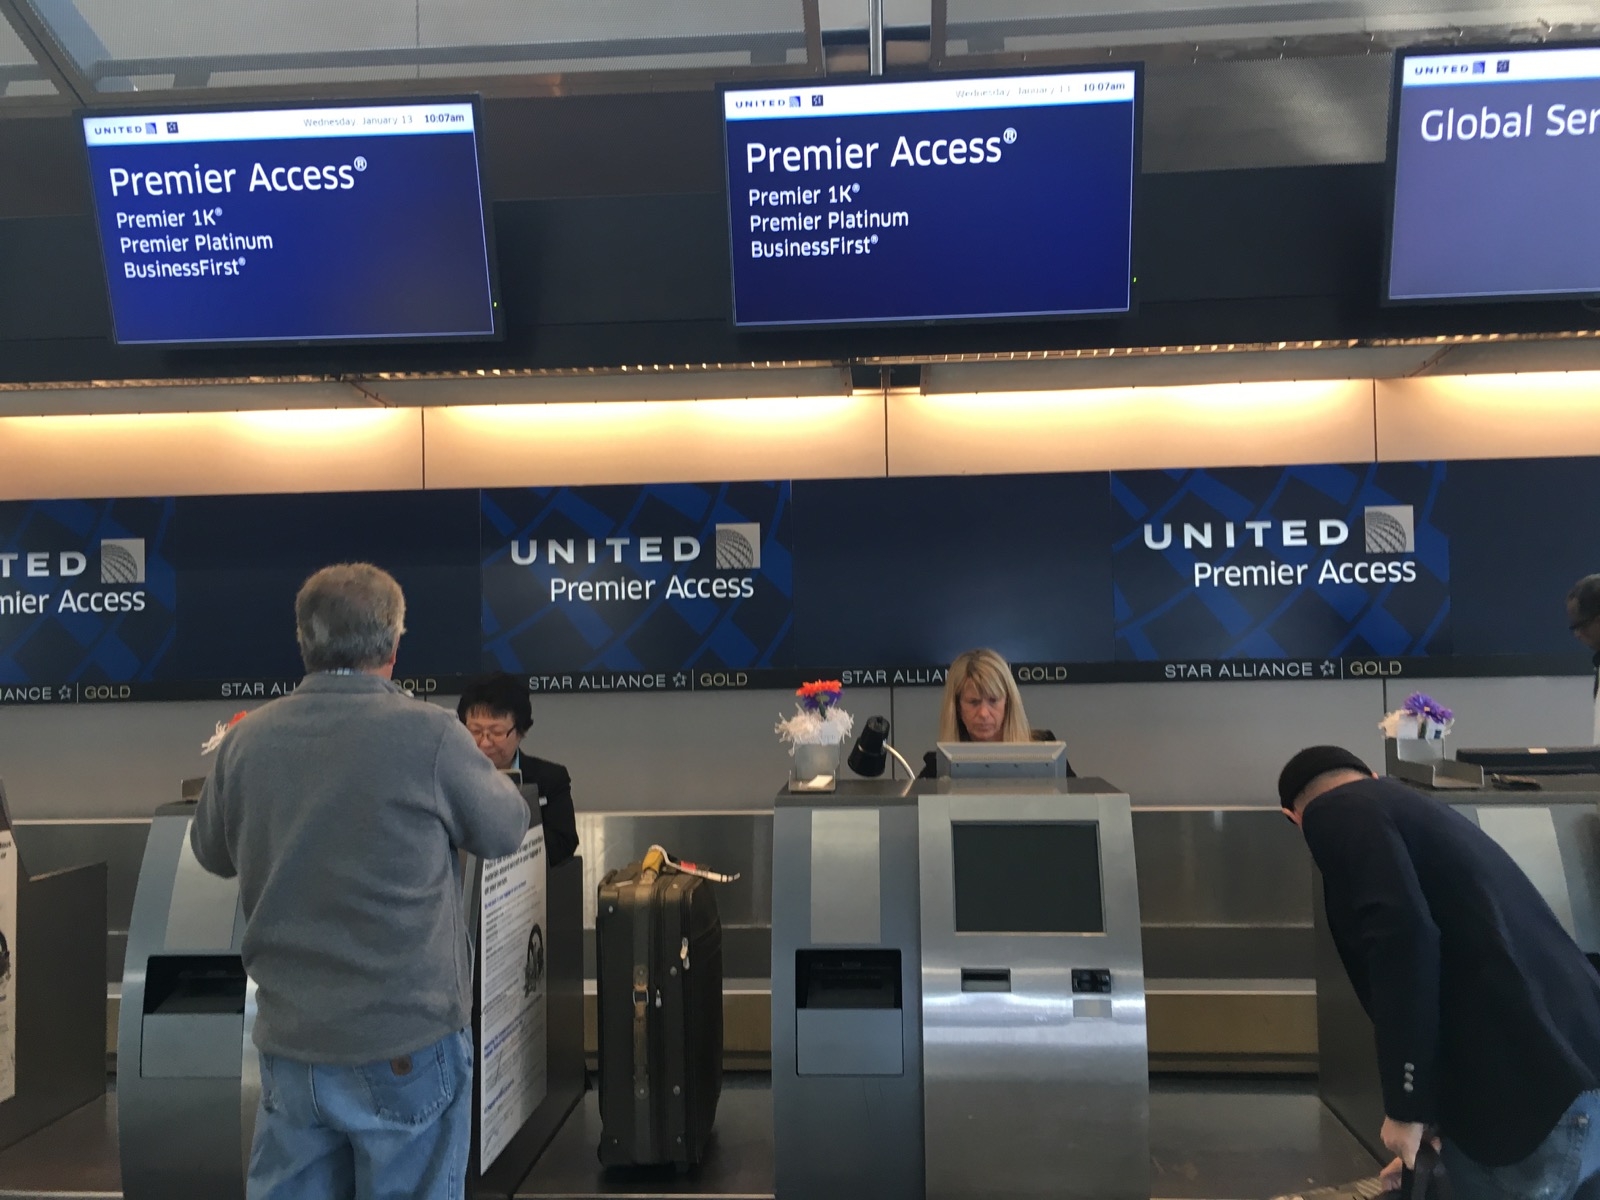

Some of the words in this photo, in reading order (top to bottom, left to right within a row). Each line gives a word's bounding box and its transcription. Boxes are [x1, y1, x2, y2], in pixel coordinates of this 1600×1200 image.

[1415, 65, 1469, 76] UNITED
[735, 98, 786, 108] UNITED
[361, 114, 399, 128] January
[402, 115, 413, 124] 13
[424, 112, 465, 123] 10:07am
[1421, 103, 1533, 143] Global
[1545, 103, 1600, 137] Ser
[94, 125, 143, 135] UNITED
[745, 138, 879, 174] Premier
[109, 162, 236, 197] Premier
[748, 186, 821, 206] Premier
[116, 209, 185, 229] Premier
[749, 212, 822, 232] Premier
[828, 209, 909, 230] Platinum
[120, 234, 189, 254] Premier
[194, 231, 273, 252] Platinum
[1143, 518, 1350, 551] UNITED
[511, 536, 701, 566] UNITED
[0, 551, 87, 578] TED
[1193, 560, 1308, 588] Premier
[1318, 557, 1417, 584] Access
[550, 577, 656, 603] Premier
[665, 575, 755, 600] Access
[57, 588, 146, 614] Access
[842, 670, 887, 685] STAR
[1018, 666, 1067, 681] GOLD
[1164, 663, 1212, 680] STAR
[1218, 660, 1313, 678] ALLIANCE
[1350, 659, 1402, 676] GOLD
[221, 681, 265, 697] STAR
[528, 676, 574, 691] STAR
[579, 673, 667, 690] ALLIANCE
[700, 672, 748, 688] GOLD
[84, 685, 131, 700] GOLD
